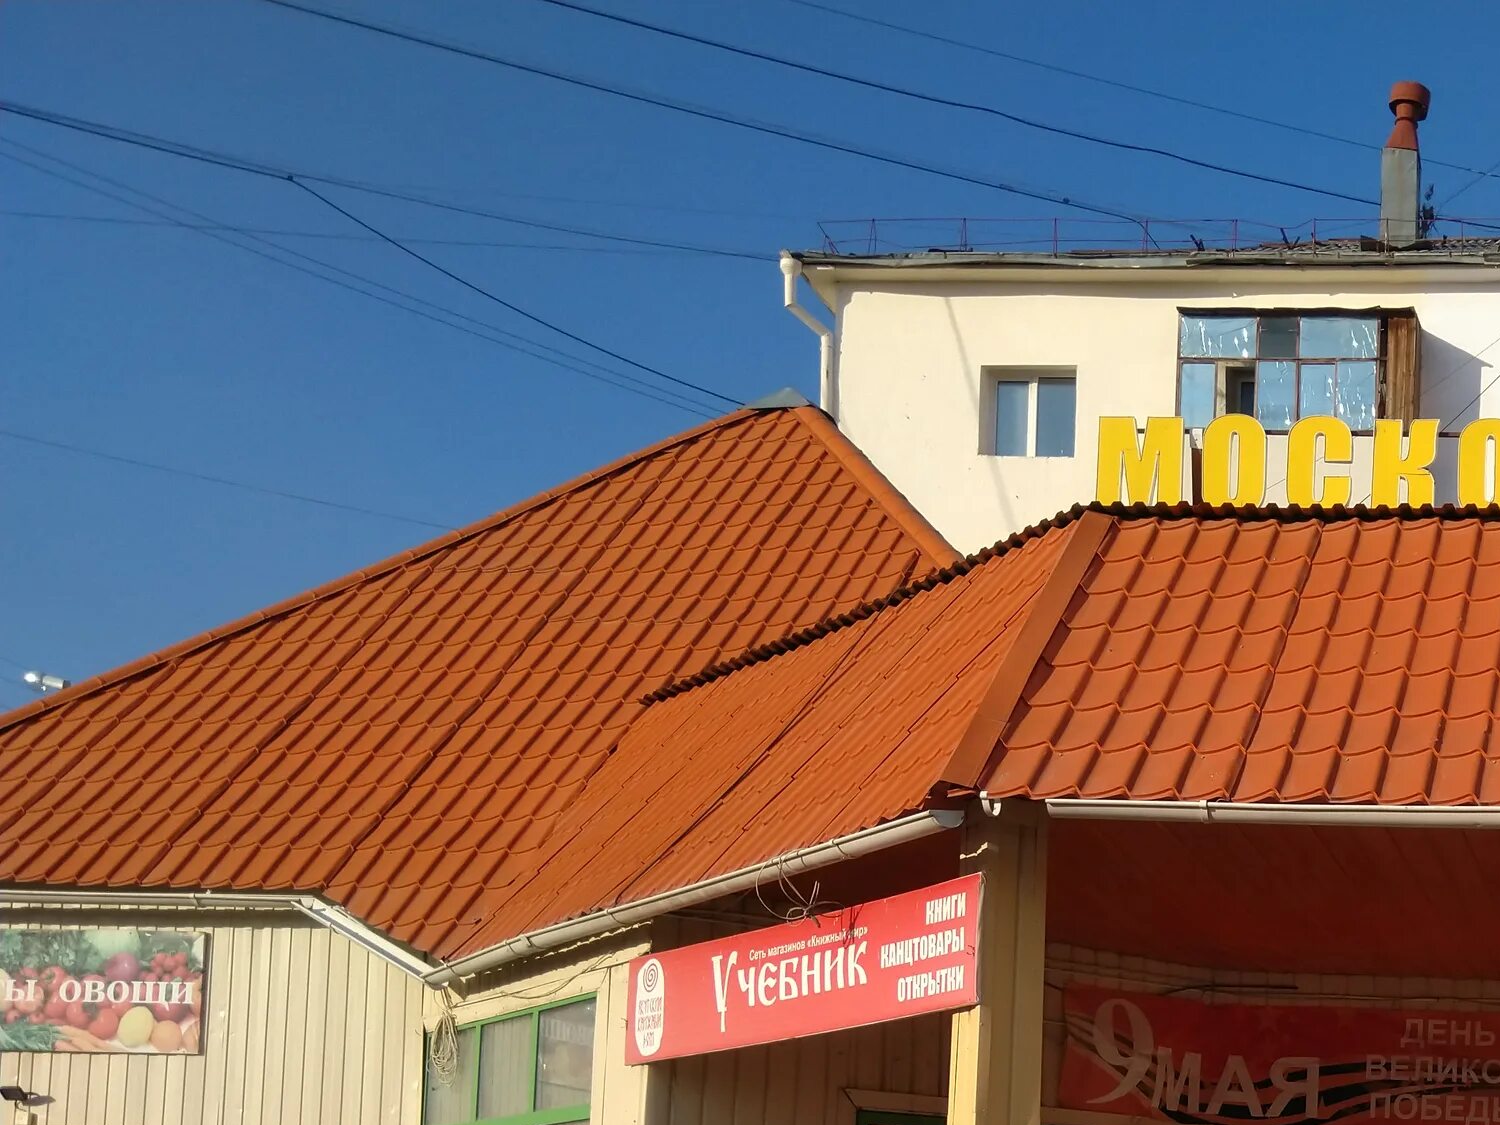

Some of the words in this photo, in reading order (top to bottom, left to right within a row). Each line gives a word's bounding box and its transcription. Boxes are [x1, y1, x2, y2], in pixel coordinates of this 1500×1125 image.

[926, 892, 966, 925] КНИГИ
[749, 948, 767, 962] Сеть
[768, 940, 806, 957] магазинов
[848, 925, 868, 940] ир»
[880, 926, 965, 969] КАНЦТОВАРЫ
[59, 979, 196, 1012] ОВОЩИ
[897, 965, 965, 1003] ОТКРЫТКИ
[1400, 1018, 1496, 1049] ДЕНЬ
[1086, 997, 1154, 1105] 9
[1151, 1046, 1320, 1119] МАЯ
